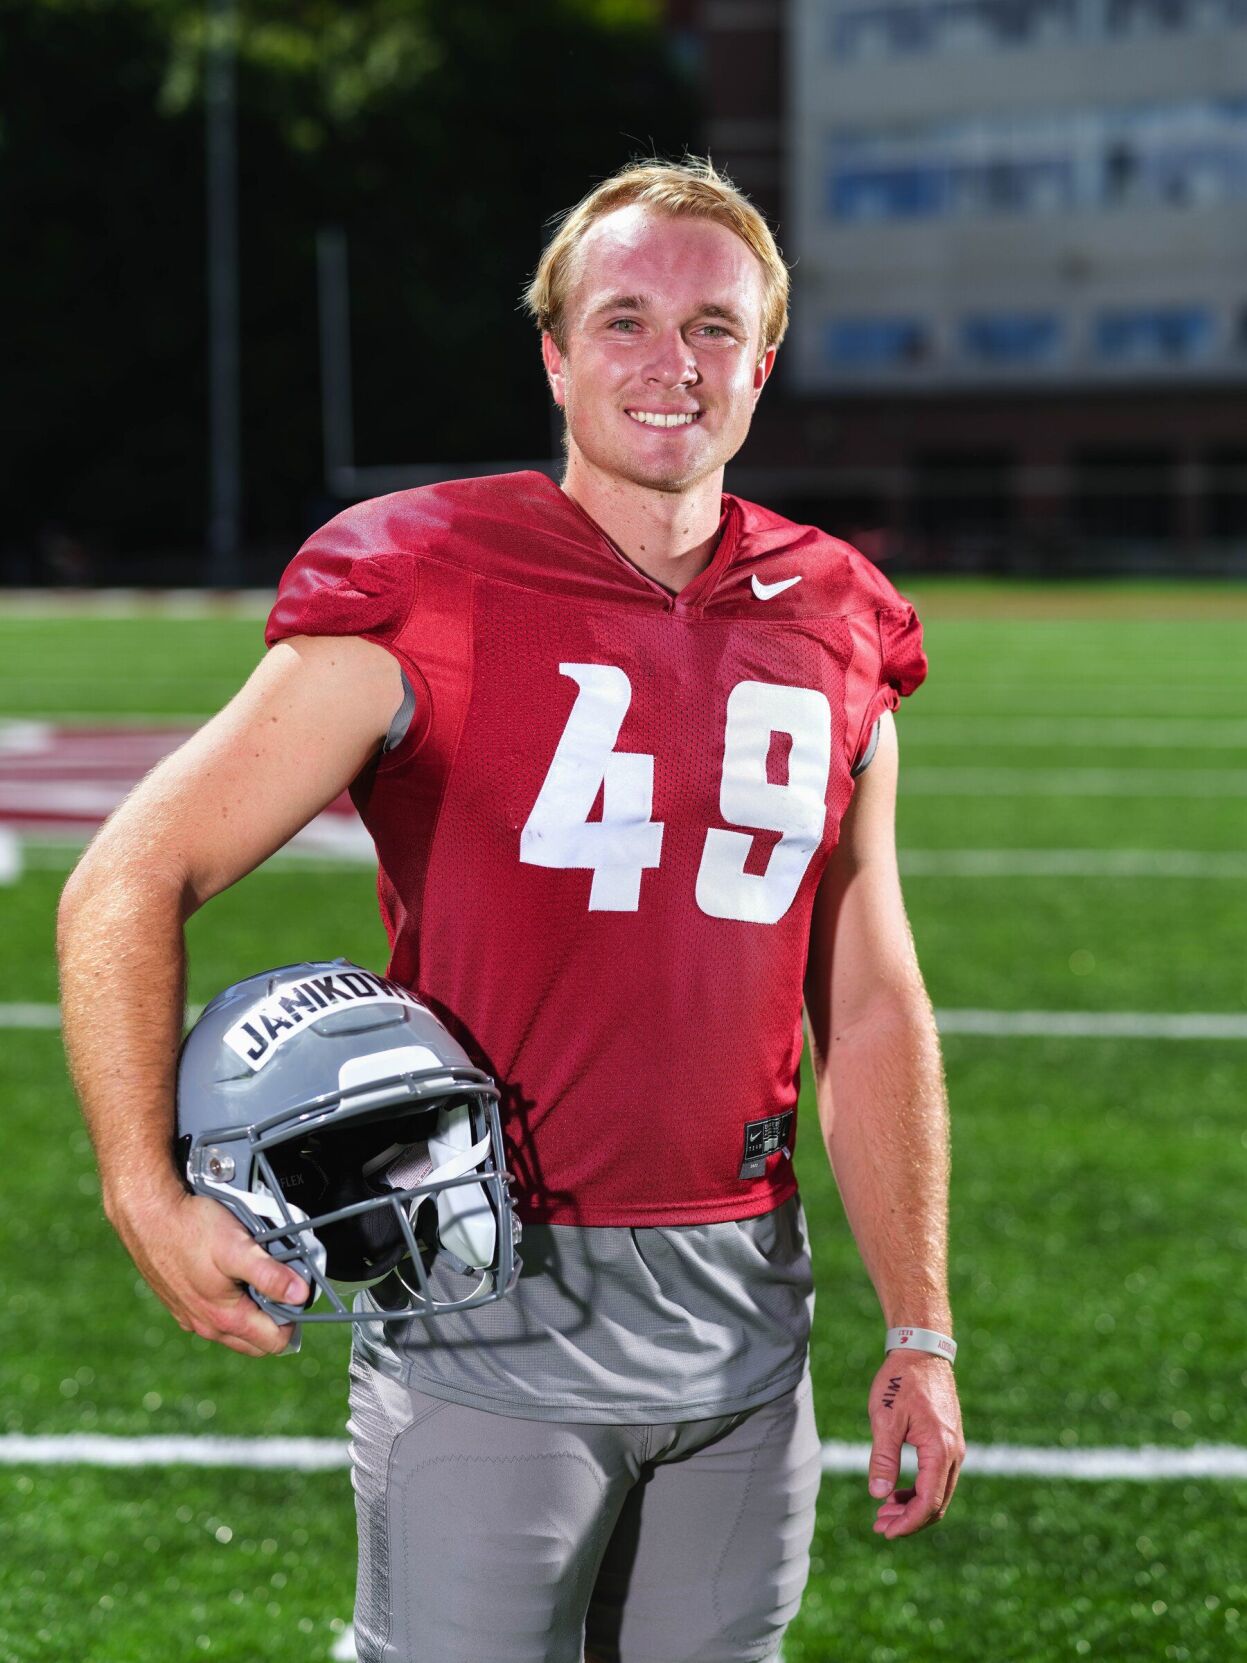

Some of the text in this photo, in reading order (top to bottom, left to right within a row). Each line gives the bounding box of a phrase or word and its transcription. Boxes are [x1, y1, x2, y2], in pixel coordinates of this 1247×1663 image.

[520, 662, 831, 925] 49
[241, 971, 416, 1061] JANIKOW
[280, 1171, 305, 1188] FLEX
[882, 1376, 902, 1410] WIN
